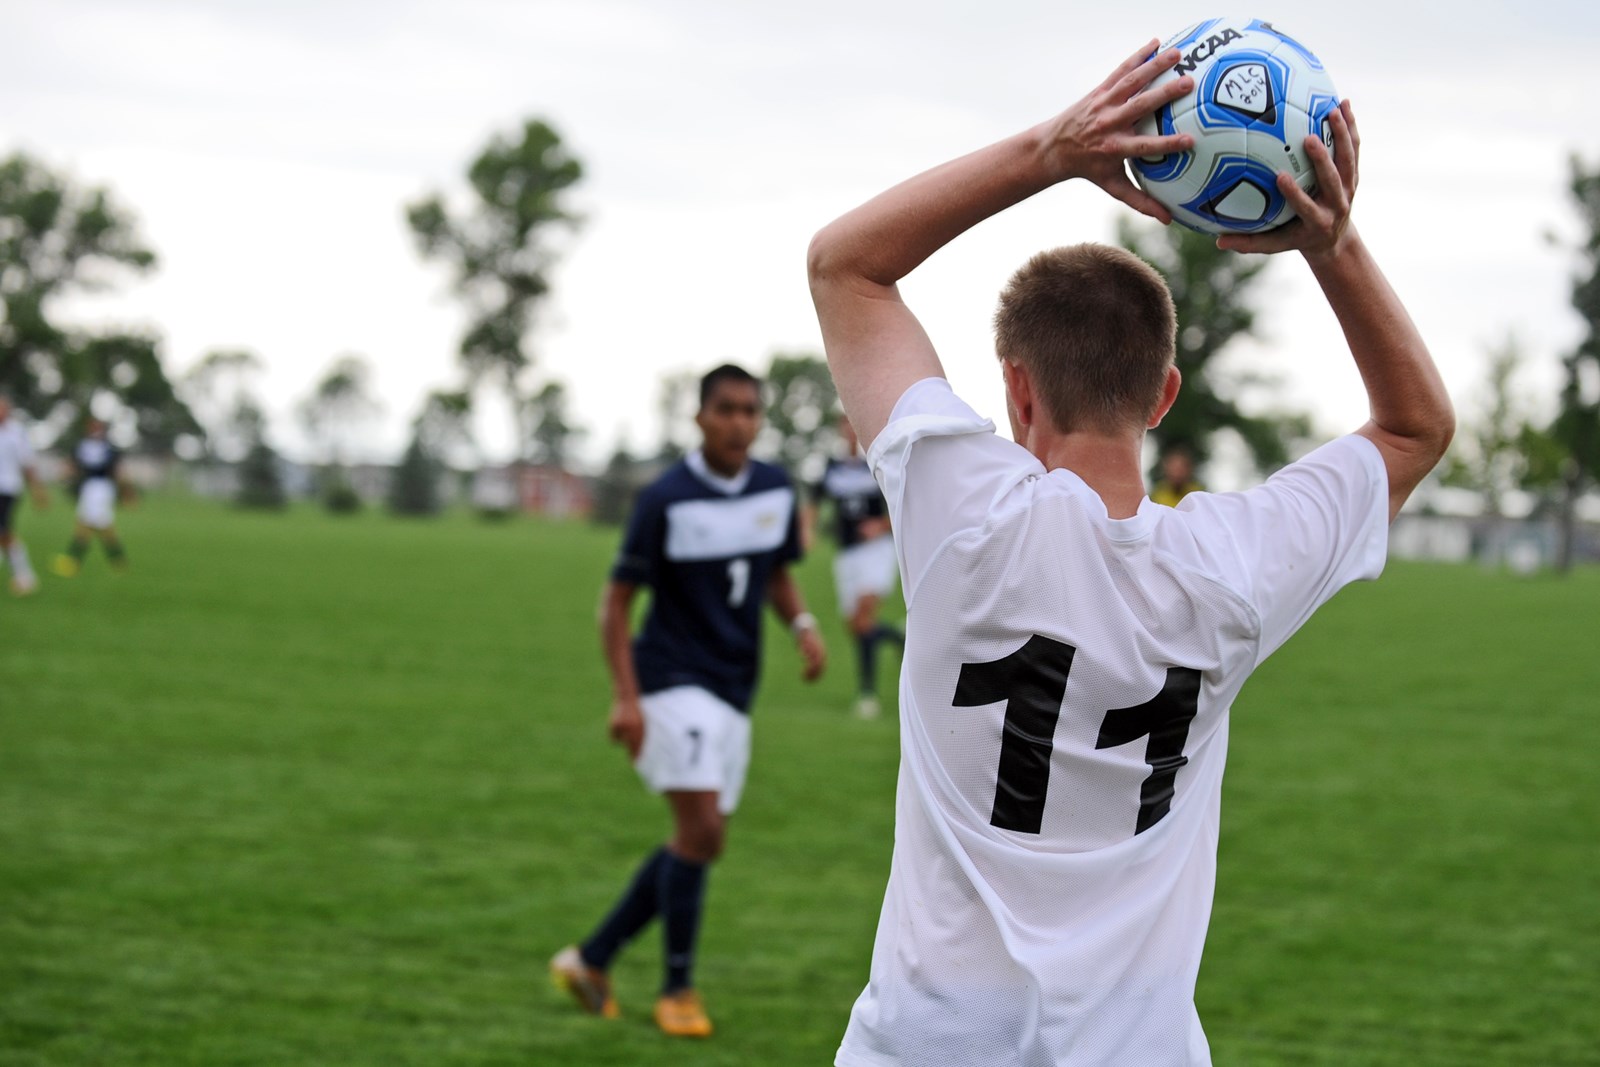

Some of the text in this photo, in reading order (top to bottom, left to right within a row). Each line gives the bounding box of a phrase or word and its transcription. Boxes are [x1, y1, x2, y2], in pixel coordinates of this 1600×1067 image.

[1173, 28, 1243, 77] NCAA
[1225, 67, 1259, 98] MLC
[1240, 77, 1265, 104] 2014
[952, 633, 1202, 836] 11
